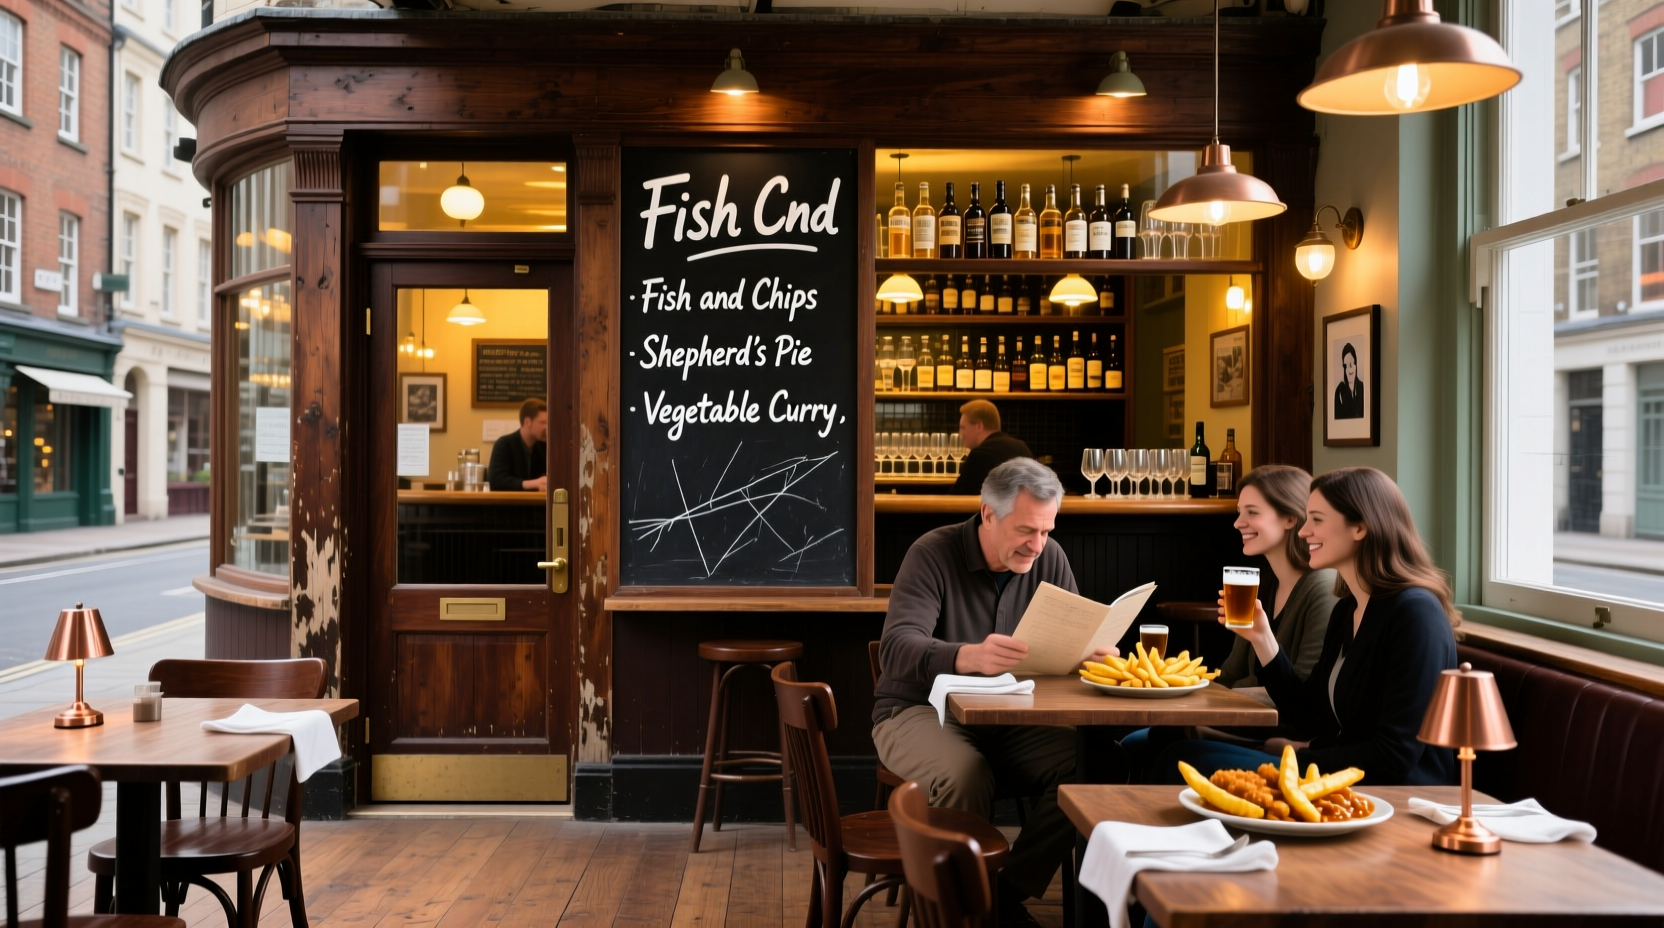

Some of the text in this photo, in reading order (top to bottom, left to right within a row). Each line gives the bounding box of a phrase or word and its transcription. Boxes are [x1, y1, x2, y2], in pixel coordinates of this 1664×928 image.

[640, 173, 841, 250] Fish Cnd
[642, 276, 818, 322] Fish and Chips
[640, 334, 813, 381] Shepherd's Pie
[643, 390, 761, 441] Vegetable
